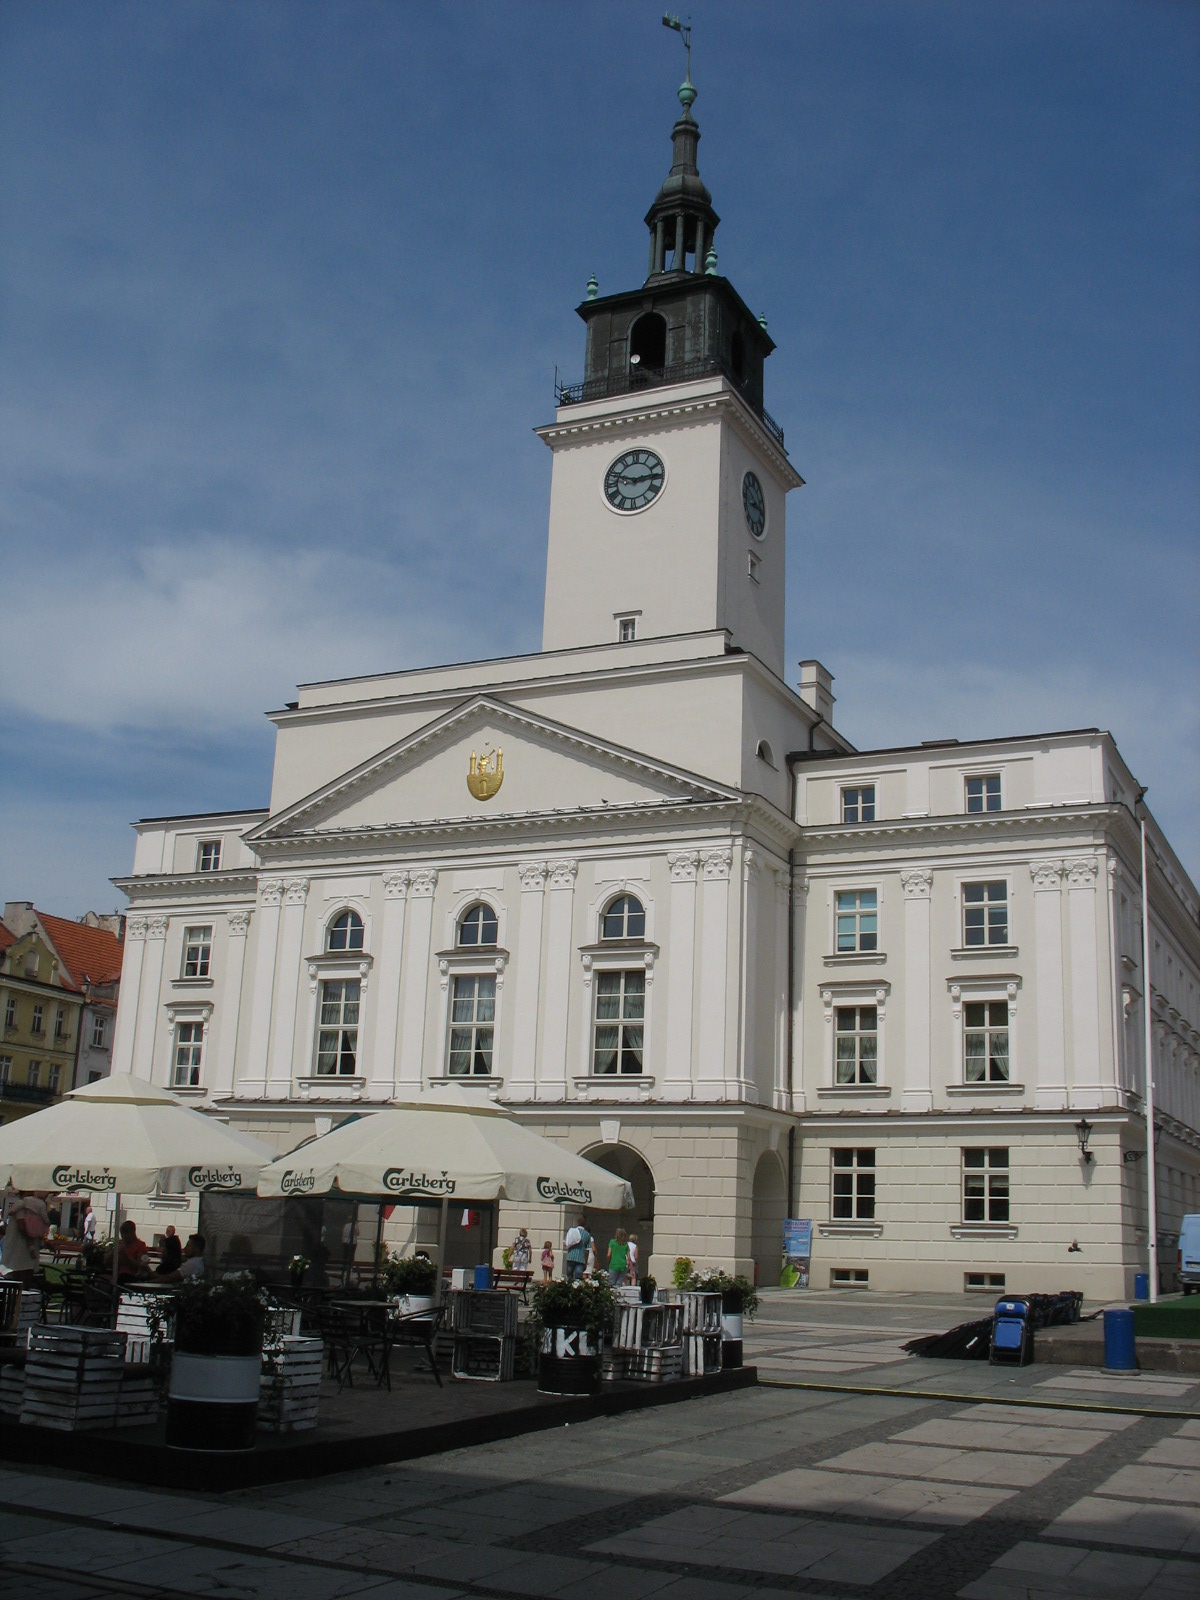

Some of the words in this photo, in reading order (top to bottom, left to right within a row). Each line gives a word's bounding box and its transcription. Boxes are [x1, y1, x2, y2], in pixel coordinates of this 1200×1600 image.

[52, 1165, 117, 1190] Carlsberg
[188, 1166, 242, 1189] Carlsberg
[281, 1169, 315, 1192] Carlsberg
[382, 1168, 456, 1194] Carlsberg
[536, 1176, 593, 1203] Carlsberg
